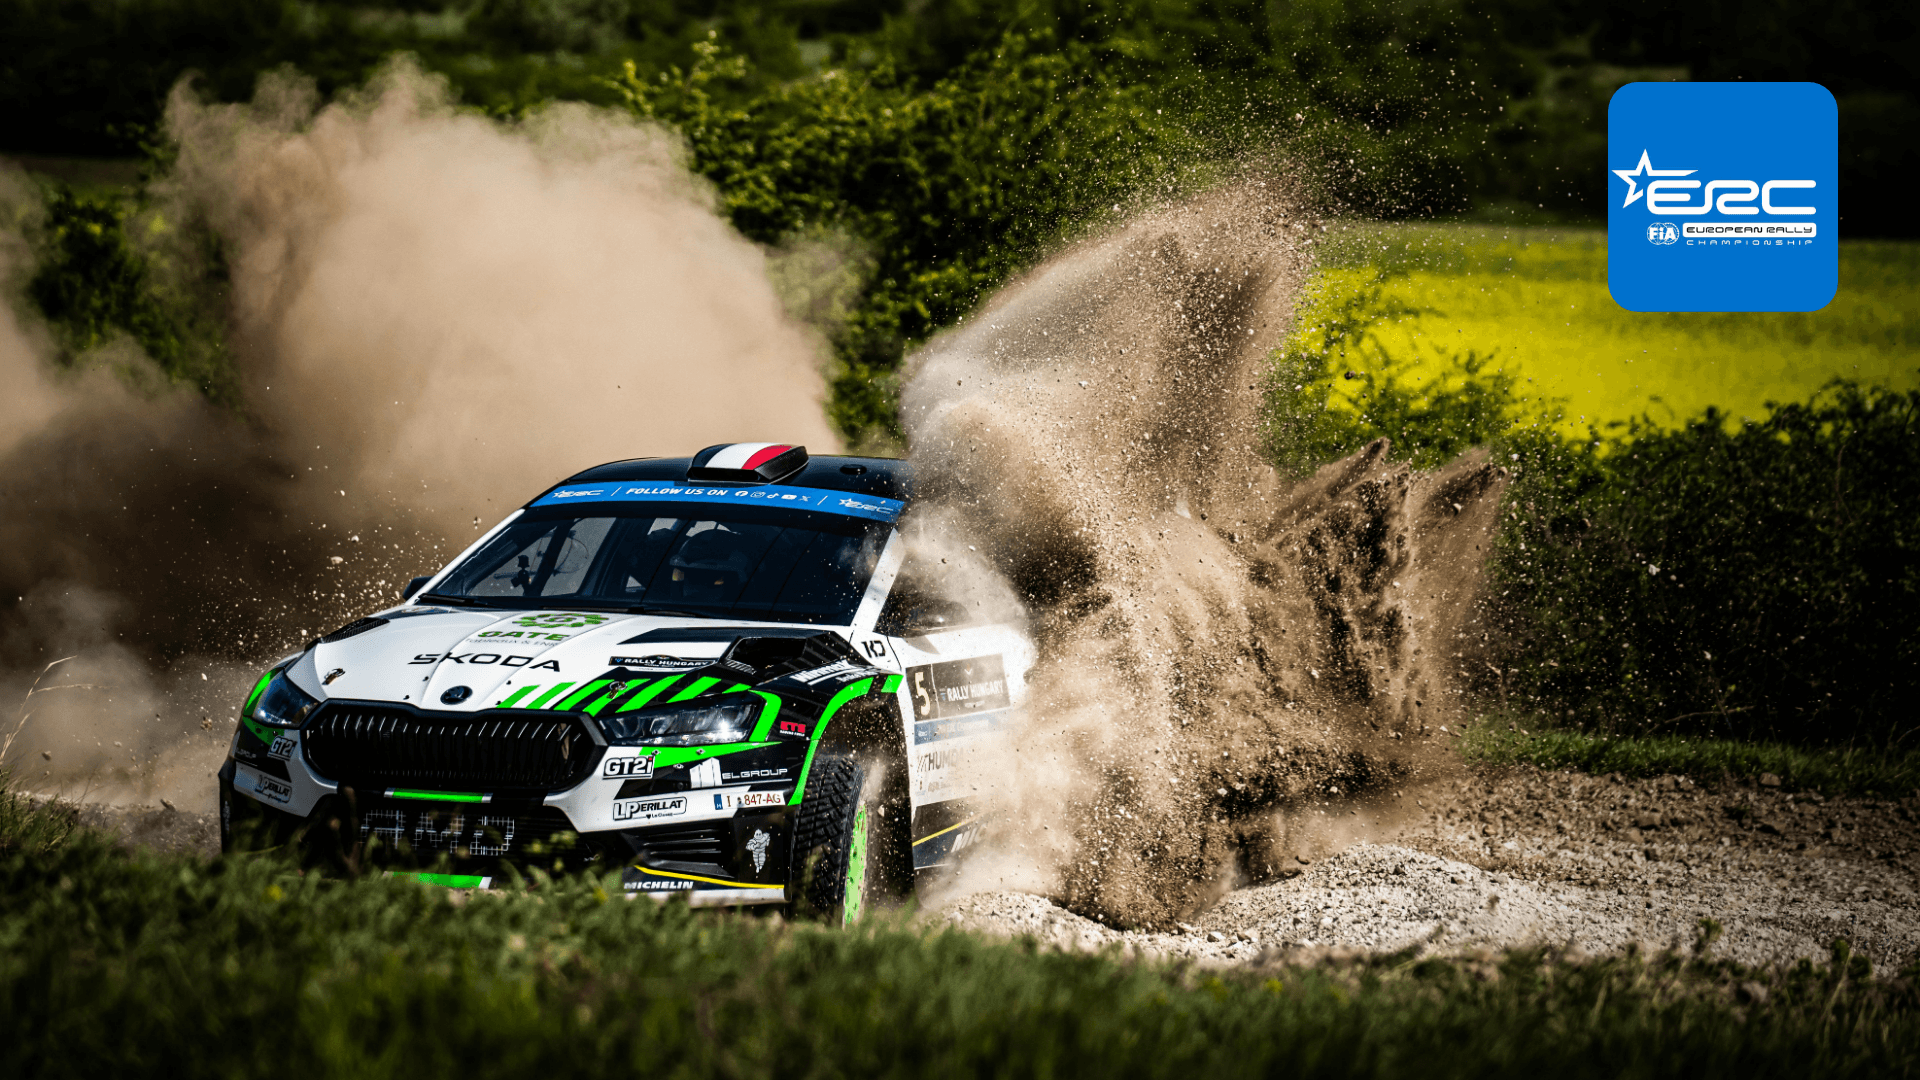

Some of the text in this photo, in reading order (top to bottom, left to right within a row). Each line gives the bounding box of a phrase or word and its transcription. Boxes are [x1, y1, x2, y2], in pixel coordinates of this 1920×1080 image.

[626, 487, 729, 497] FOLLOW US ON
[914, 671, 931, 717] 5
[946, 685, 970, 702] RALLY
[604, 755, 653, 776] GT2i
[624, 881, 694, 890] MICHELIN
